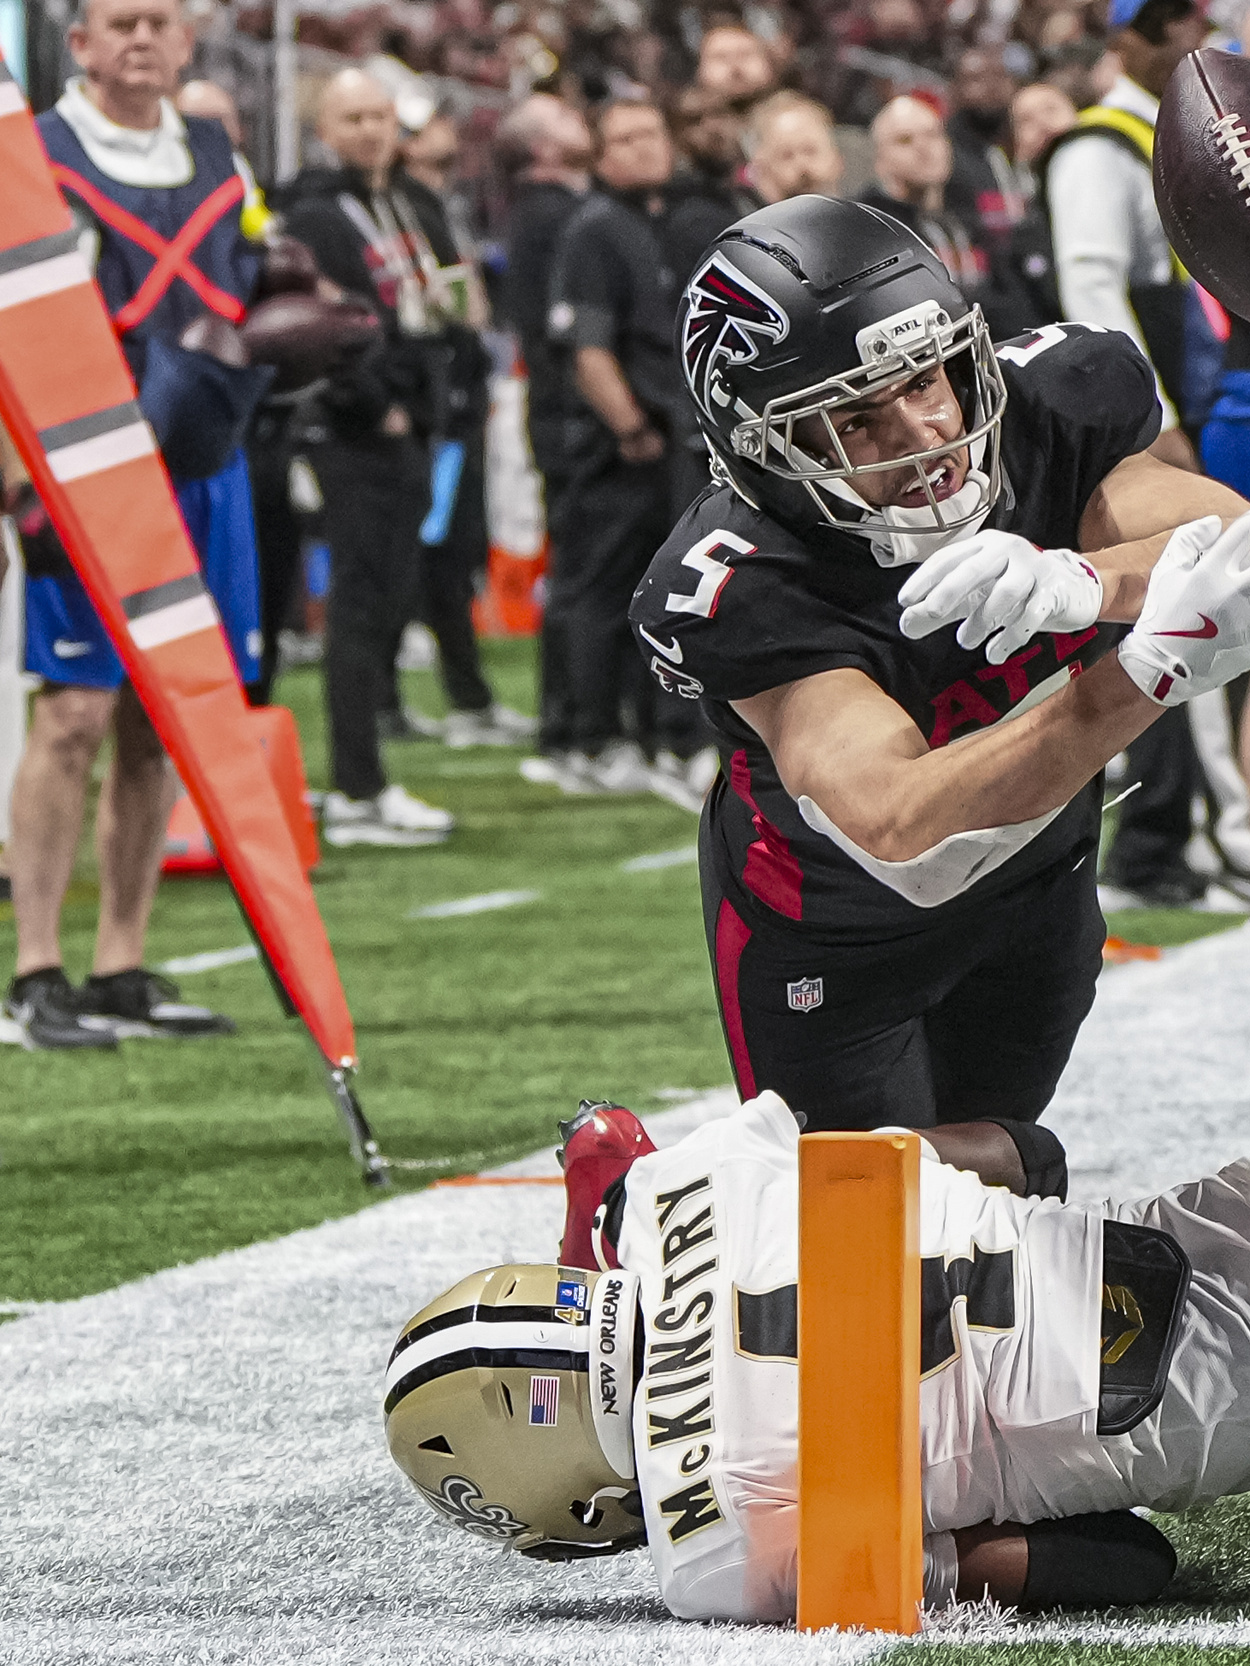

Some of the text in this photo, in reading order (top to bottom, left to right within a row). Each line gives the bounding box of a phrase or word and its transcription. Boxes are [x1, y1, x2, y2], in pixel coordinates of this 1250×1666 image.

[889, 318, 922, 339] ATL
[664, 528, 758, 618] 5
[794, 991, 819, 1006] NFL
[555, 1308, 585, 1326] 4
[645, 1172, 726, 1546] McKINSTRY
